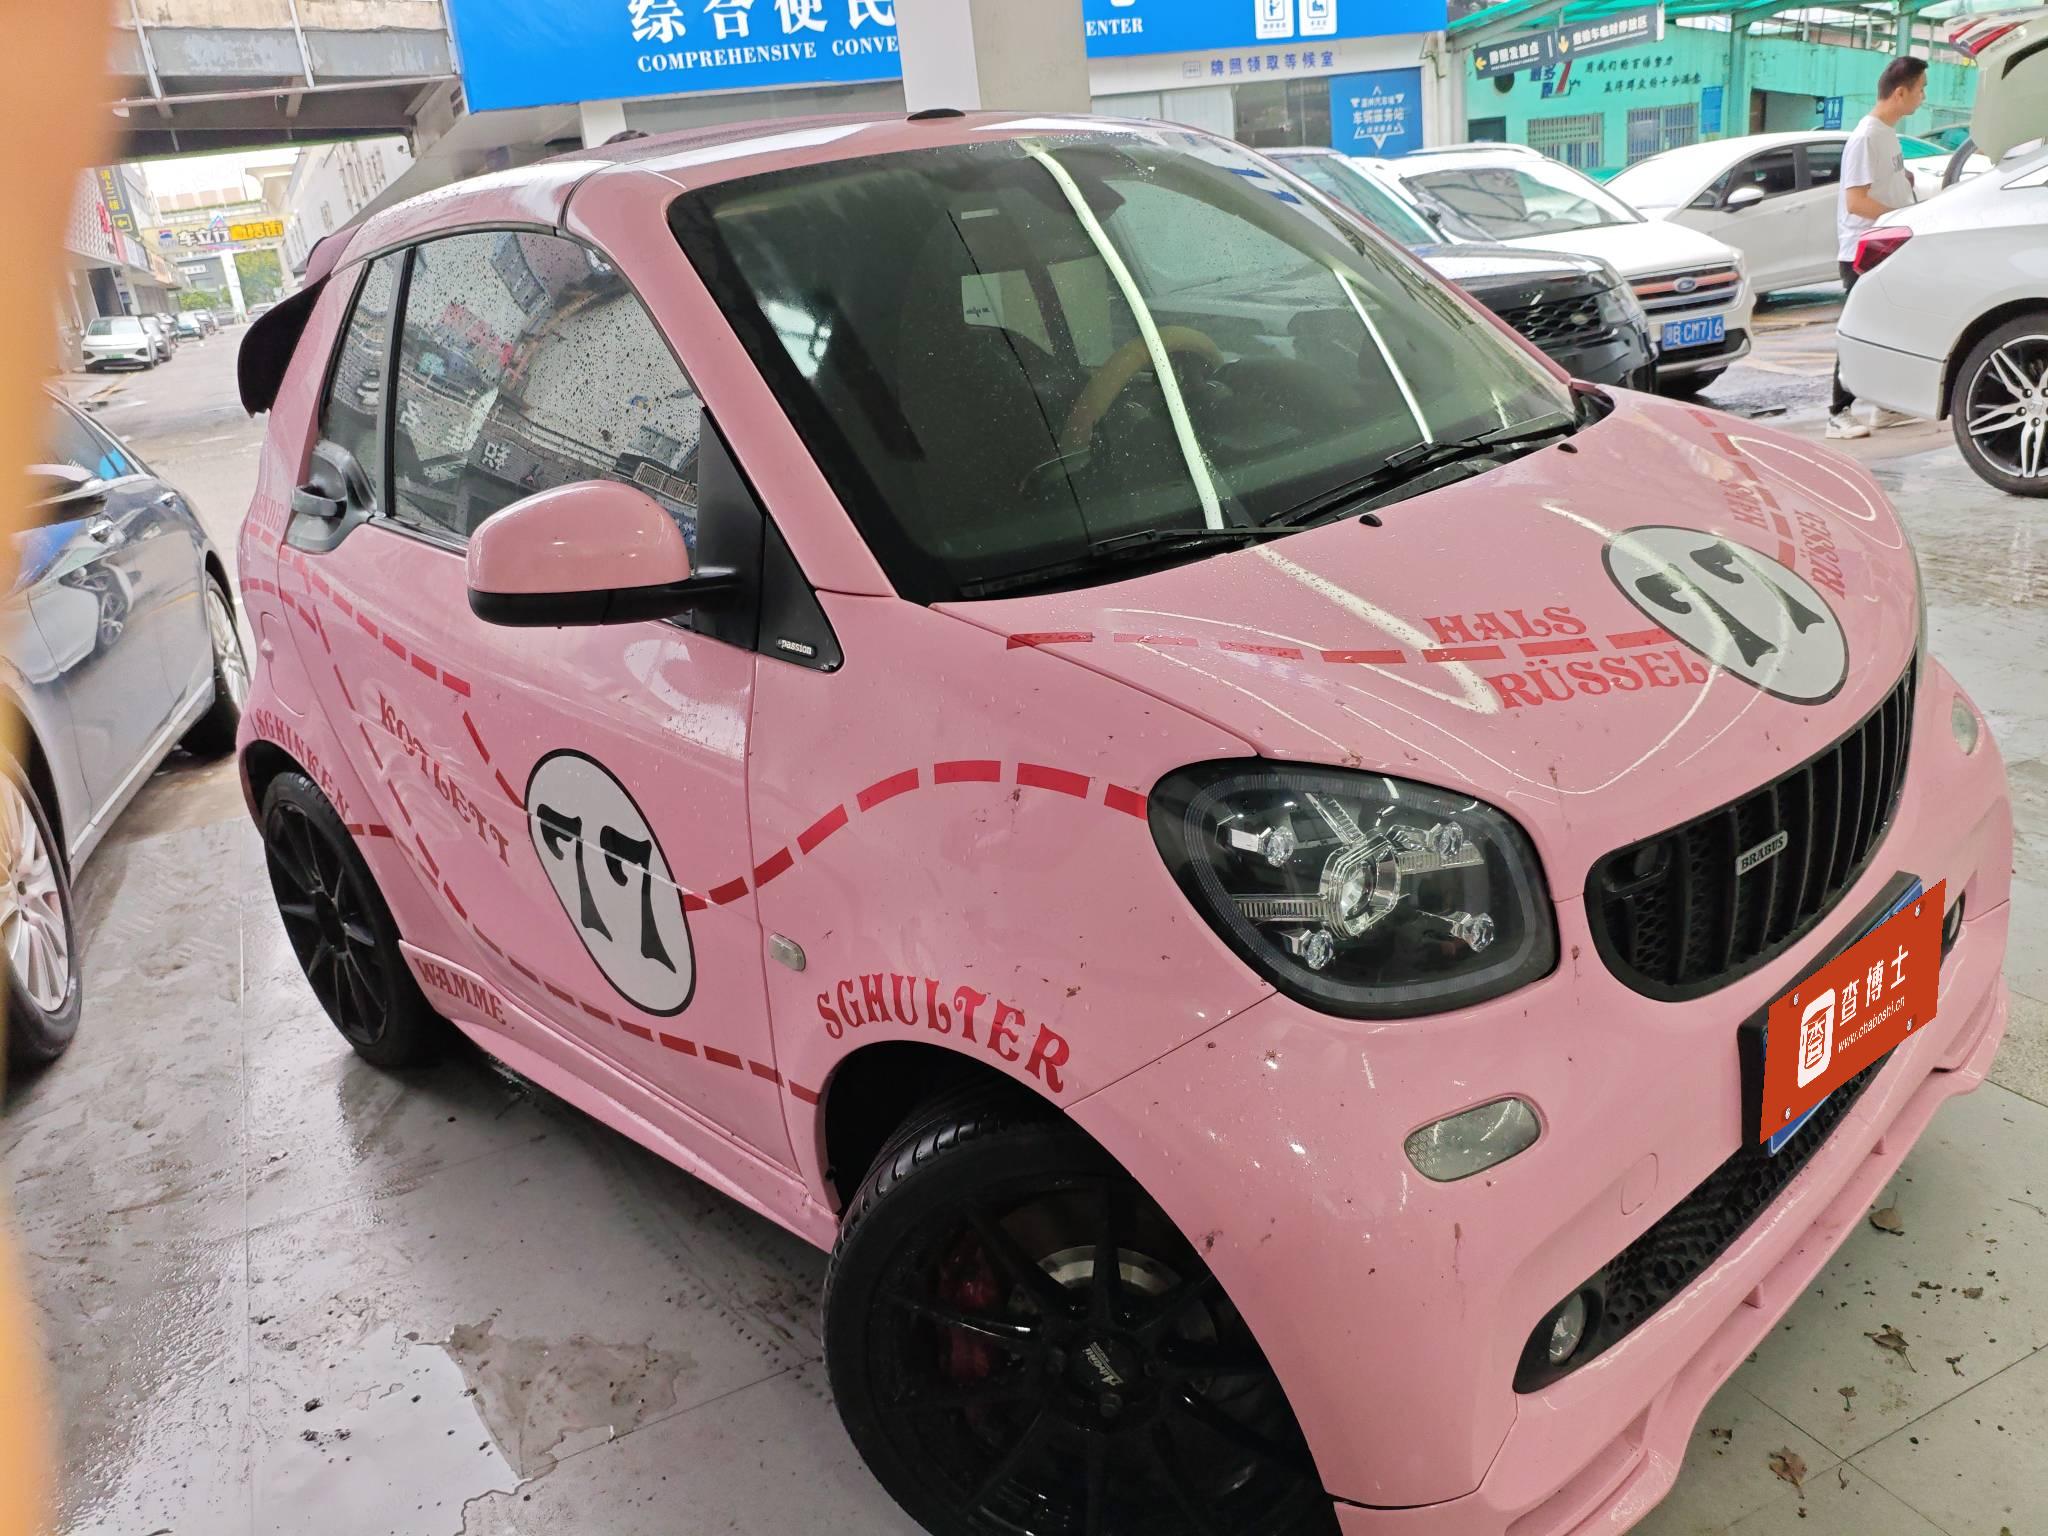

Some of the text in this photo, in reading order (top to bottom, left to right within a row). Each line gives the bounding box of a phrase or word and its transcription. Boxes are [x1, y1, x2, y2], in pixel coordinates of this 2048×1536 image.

[637, 42, 816, 73] COMPREHENSIVE
[1211, 50, 1334, 77] 牌照领取等候室
[1719, 479, 1769, 531] HALS
[781, 639, 812, 655] passion
[1423, 606, 1587, 644] HALS
[1484, 649, 1709, 709] RÜSSEL
[378, 690, 510, 867] KOTLETT
[1741, 835, 1784, 871] BRABUS
[536, 803, 677, 974] 77
[413, 958, 506, 1026] WAMME
